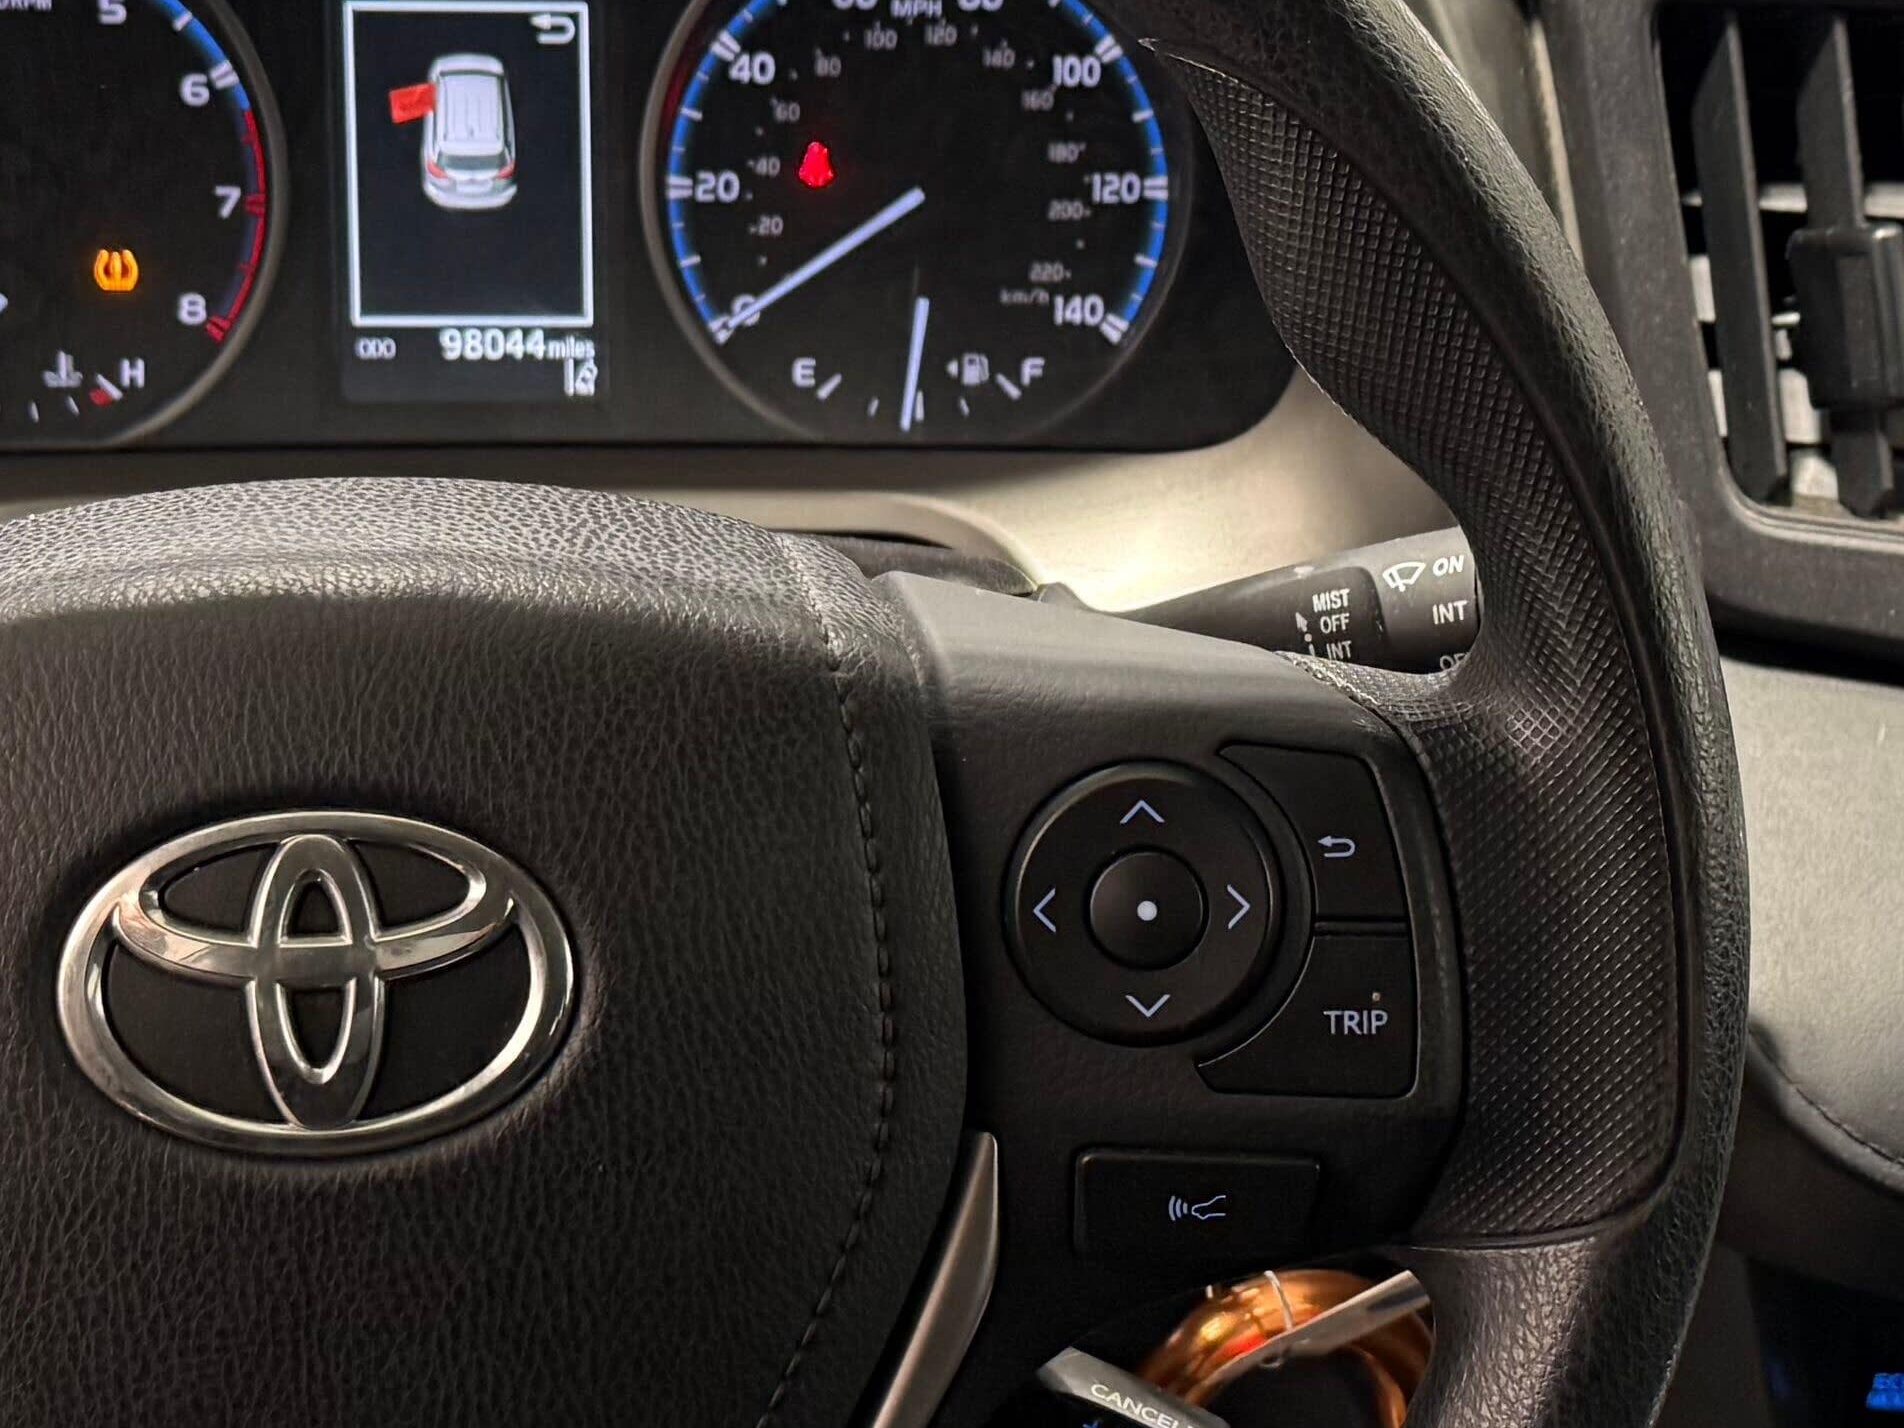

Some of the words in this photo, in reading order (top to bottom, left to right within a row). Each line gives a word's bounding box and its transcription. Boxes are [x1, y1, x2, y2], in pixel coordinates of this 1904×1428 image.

[729, 53, 775, 85] 40
[1053, 56, 1101, 87] 100
[181, 75, 210, 105] 6
[215, 186, 242, 218] 7
[695, 172, 740, 203] 20
[1093, 173, 1141, 204] 120
[179, 293, 206, 325] 8
[1053, 295, 1104, 326] 140
[439, 328, 544, 360] 98044
[121, 359, 145, 387] H
[793, 357, 816, 386] E
[1022, 357, 1045, 386] F
[1433, 555, 1465, 576] ON
[1312, 588, 1350, 612] MIST
[1432, 600, 1467, 624] INT
[1320, 614, 1350, 633] OFF
[1326, 641, 1352, 660] INT
[1323, 1009, 1388, 1035] TRIP
